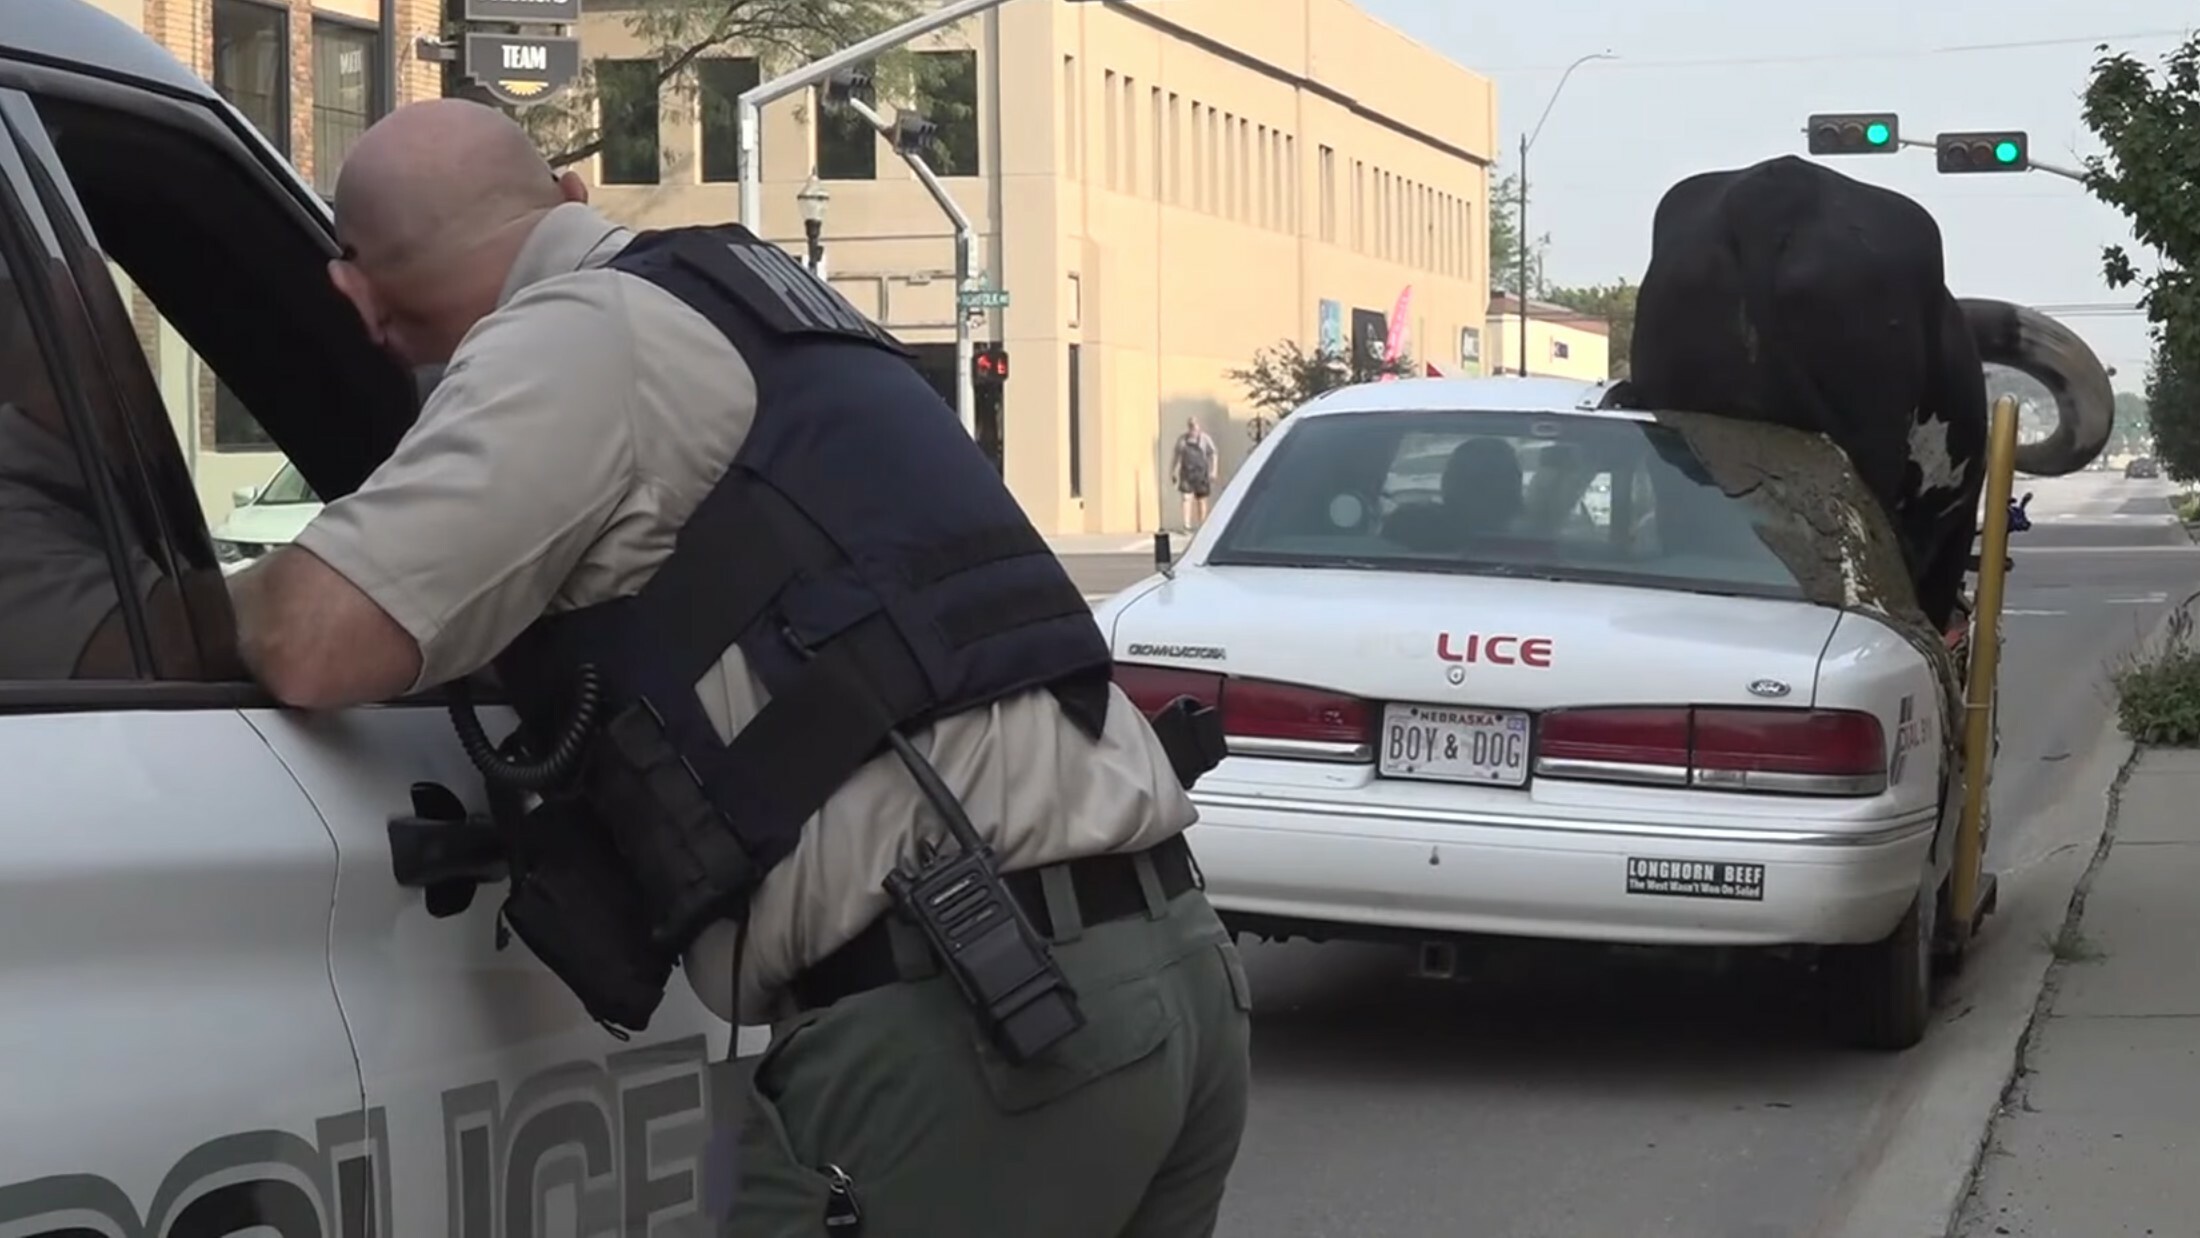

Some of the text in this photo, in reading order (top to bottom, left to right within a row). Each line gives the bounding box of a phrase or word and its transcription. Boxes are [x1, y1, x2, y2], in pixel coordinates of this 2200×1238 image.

[502, 44, 547, 70] TEAM
[1437, 632, 1553, 668] LICE
[1420, 710, 1494, 726] NEBRASKA
[1389, 725, 1521, 768] BOY & DOG
[1629, 859, 1763, 884] LONGHORN BEEF
[1629, 878, 1646, 890] The
[1647, 879, 1669, 892] West
[1670, 881, 1700, 893] Wasn't
[1701, 882, 1720, 895] Won
[1721, 884, 1734, 895] On
[0, 1034, 712, 1238] ICE
